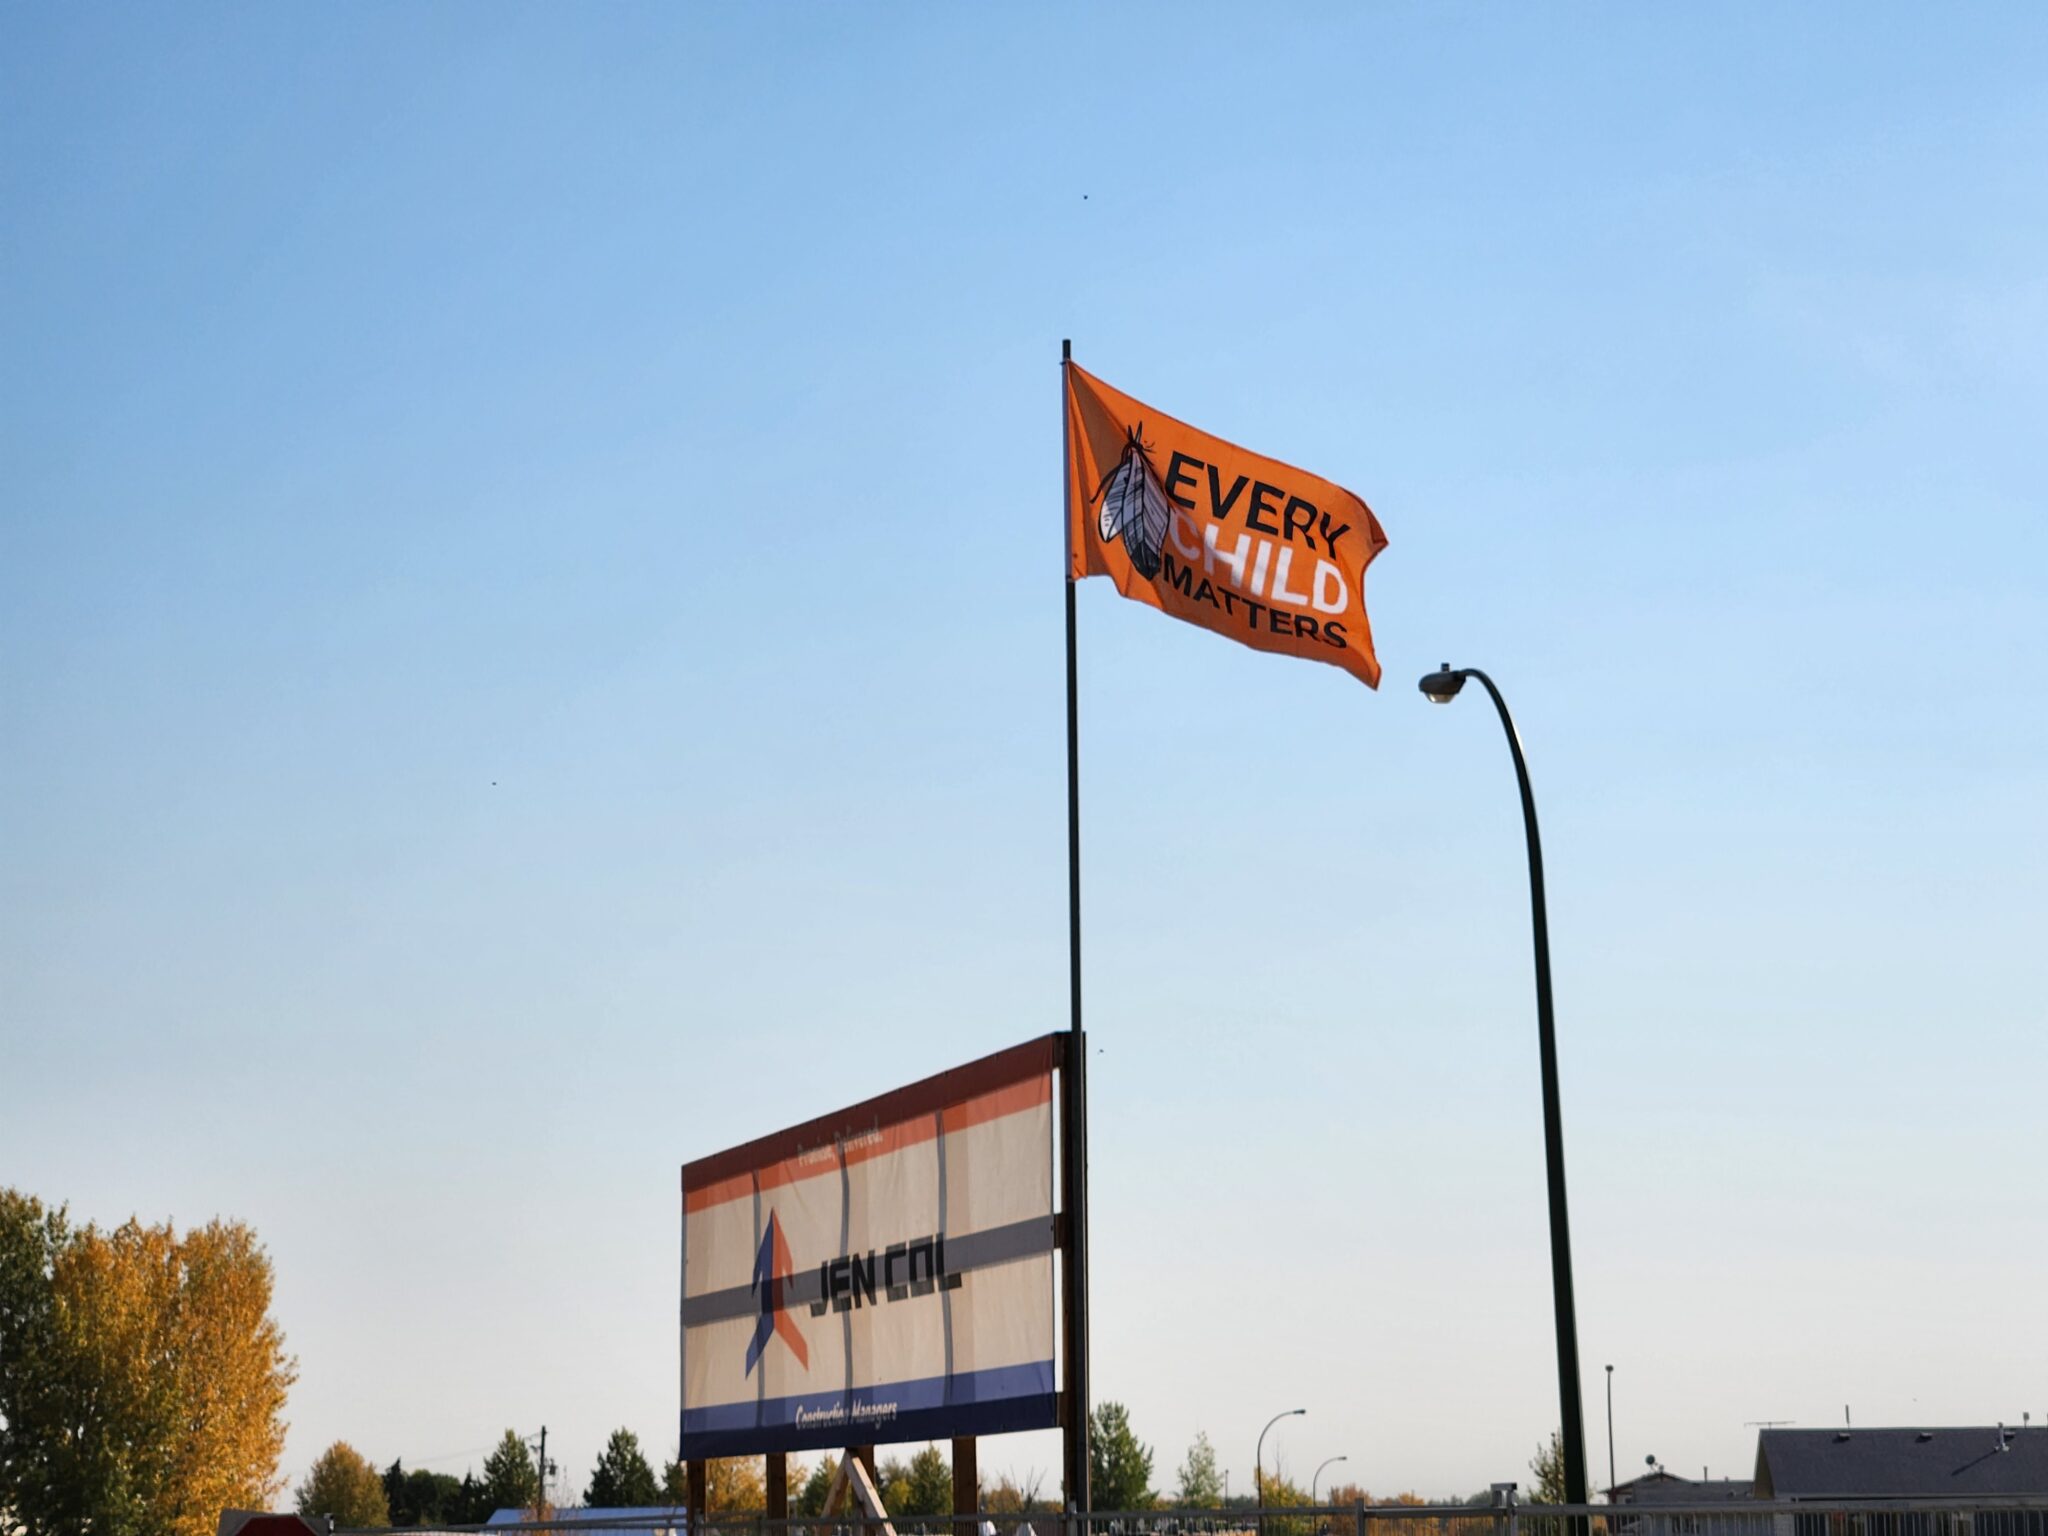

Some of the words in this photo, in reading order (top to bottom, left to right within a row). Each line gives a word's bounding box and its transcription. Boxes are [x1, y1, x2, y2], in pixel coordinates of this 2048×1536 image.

[1166, 451, 1350, 560] EVERY
[1164, 554, 1347, 649] MATTERS
[1168, 510, 1348, 614] CHILD
[795, 1402, 849, 1430] Construction
[850, 1398, 898, 1429] Managers
